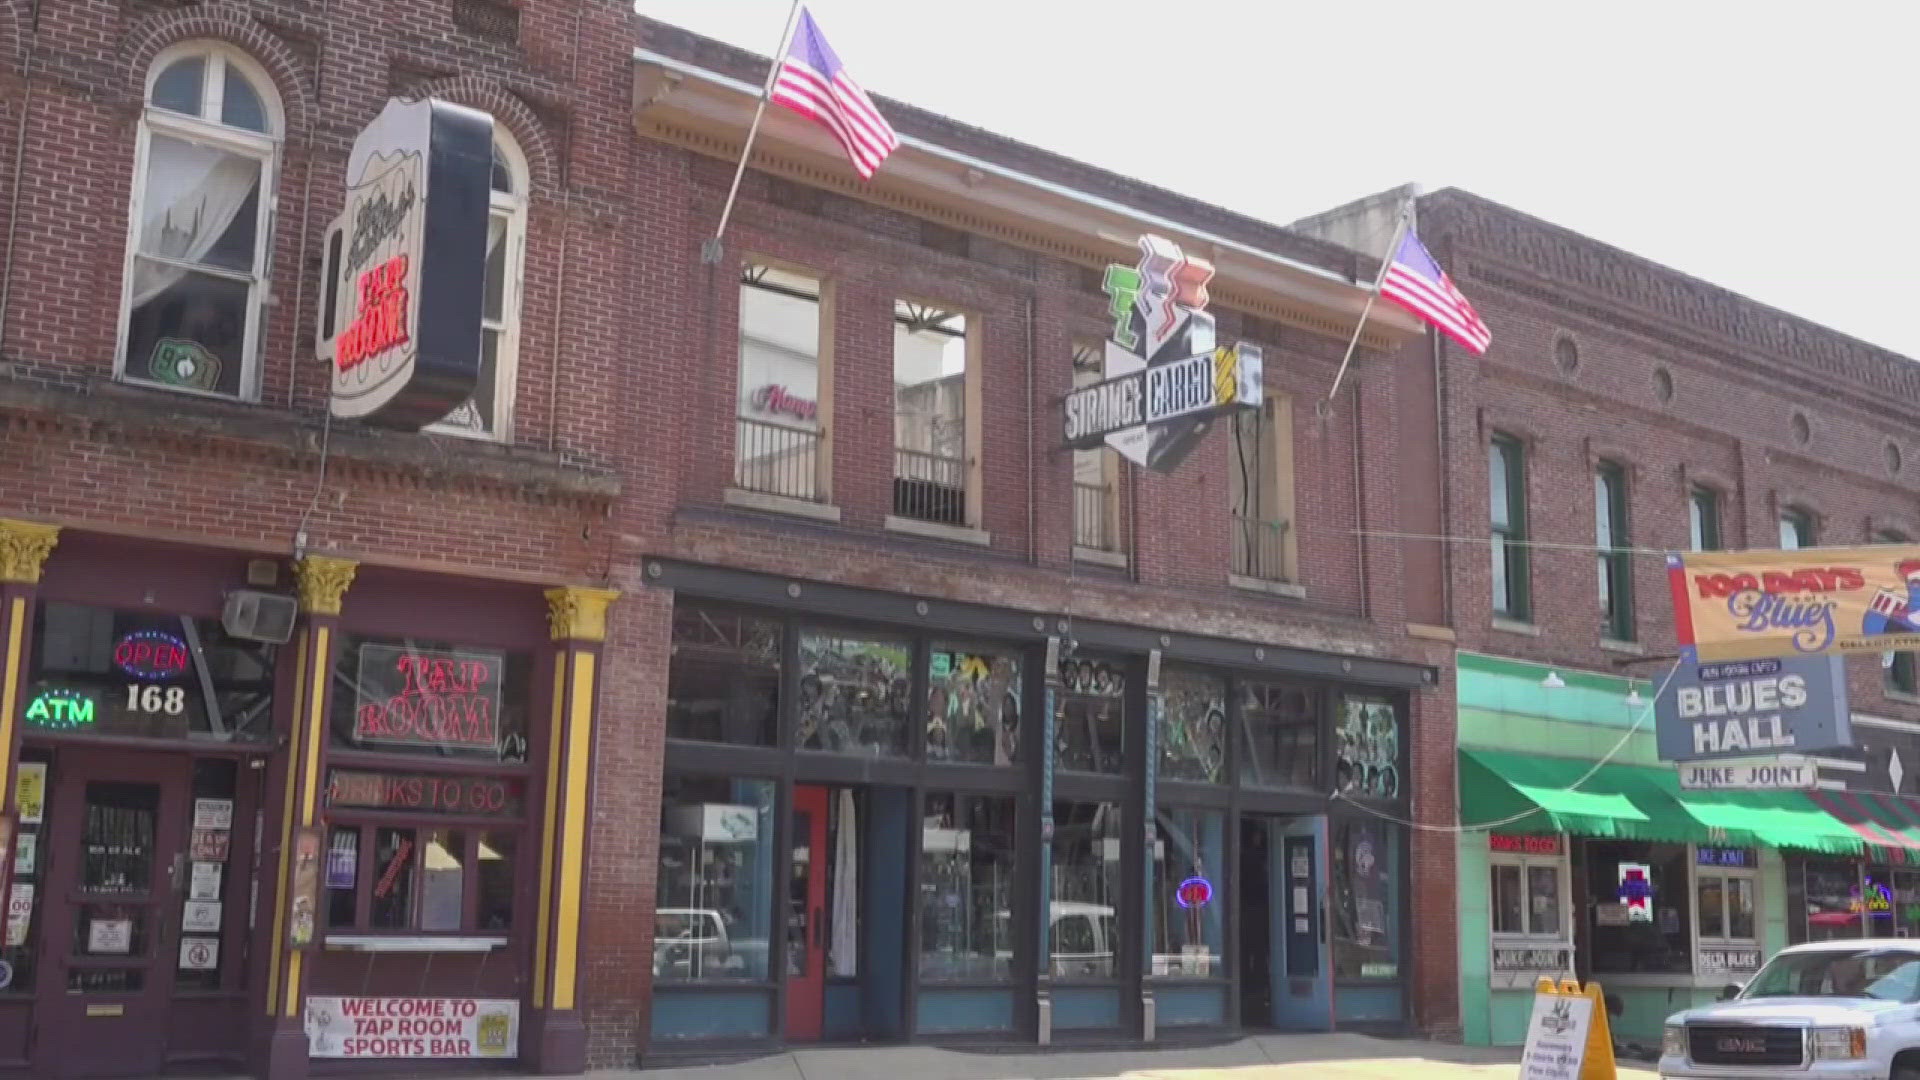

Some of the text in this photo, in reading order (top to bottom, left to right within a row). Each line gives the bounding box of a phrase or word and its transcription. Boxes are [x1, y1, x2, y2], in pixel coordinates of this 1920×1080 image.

[1150, 356, 1212, 416] CARGO
[1694, 567, 1866, 599] 100 DAYS
[1727, 587, 1838, 653] Blues
[115, 640, 189, 673] OPEN
[396, 655, 489, 697] TAP
[26, 697, 94, 722] ATM
[127, 683, 185, 715] 168
[1677, 674, 1807, 719] BLUES
[357, 694, 493, 742] ROOM
[1693, 714, 1795, 754] HALL
[1688, 765, 1805, 785] JUKE JOINT
[334, 776, 505, 811] DRINKS TO GO
[341, 999, 477, 1018] WELCOME TO
[353, 1018, 463, 1036] TAP ROOM
[343, 1038, 471, 1056] SPORTS BAR
[1717, 1038, 1767, 1053] GMC
